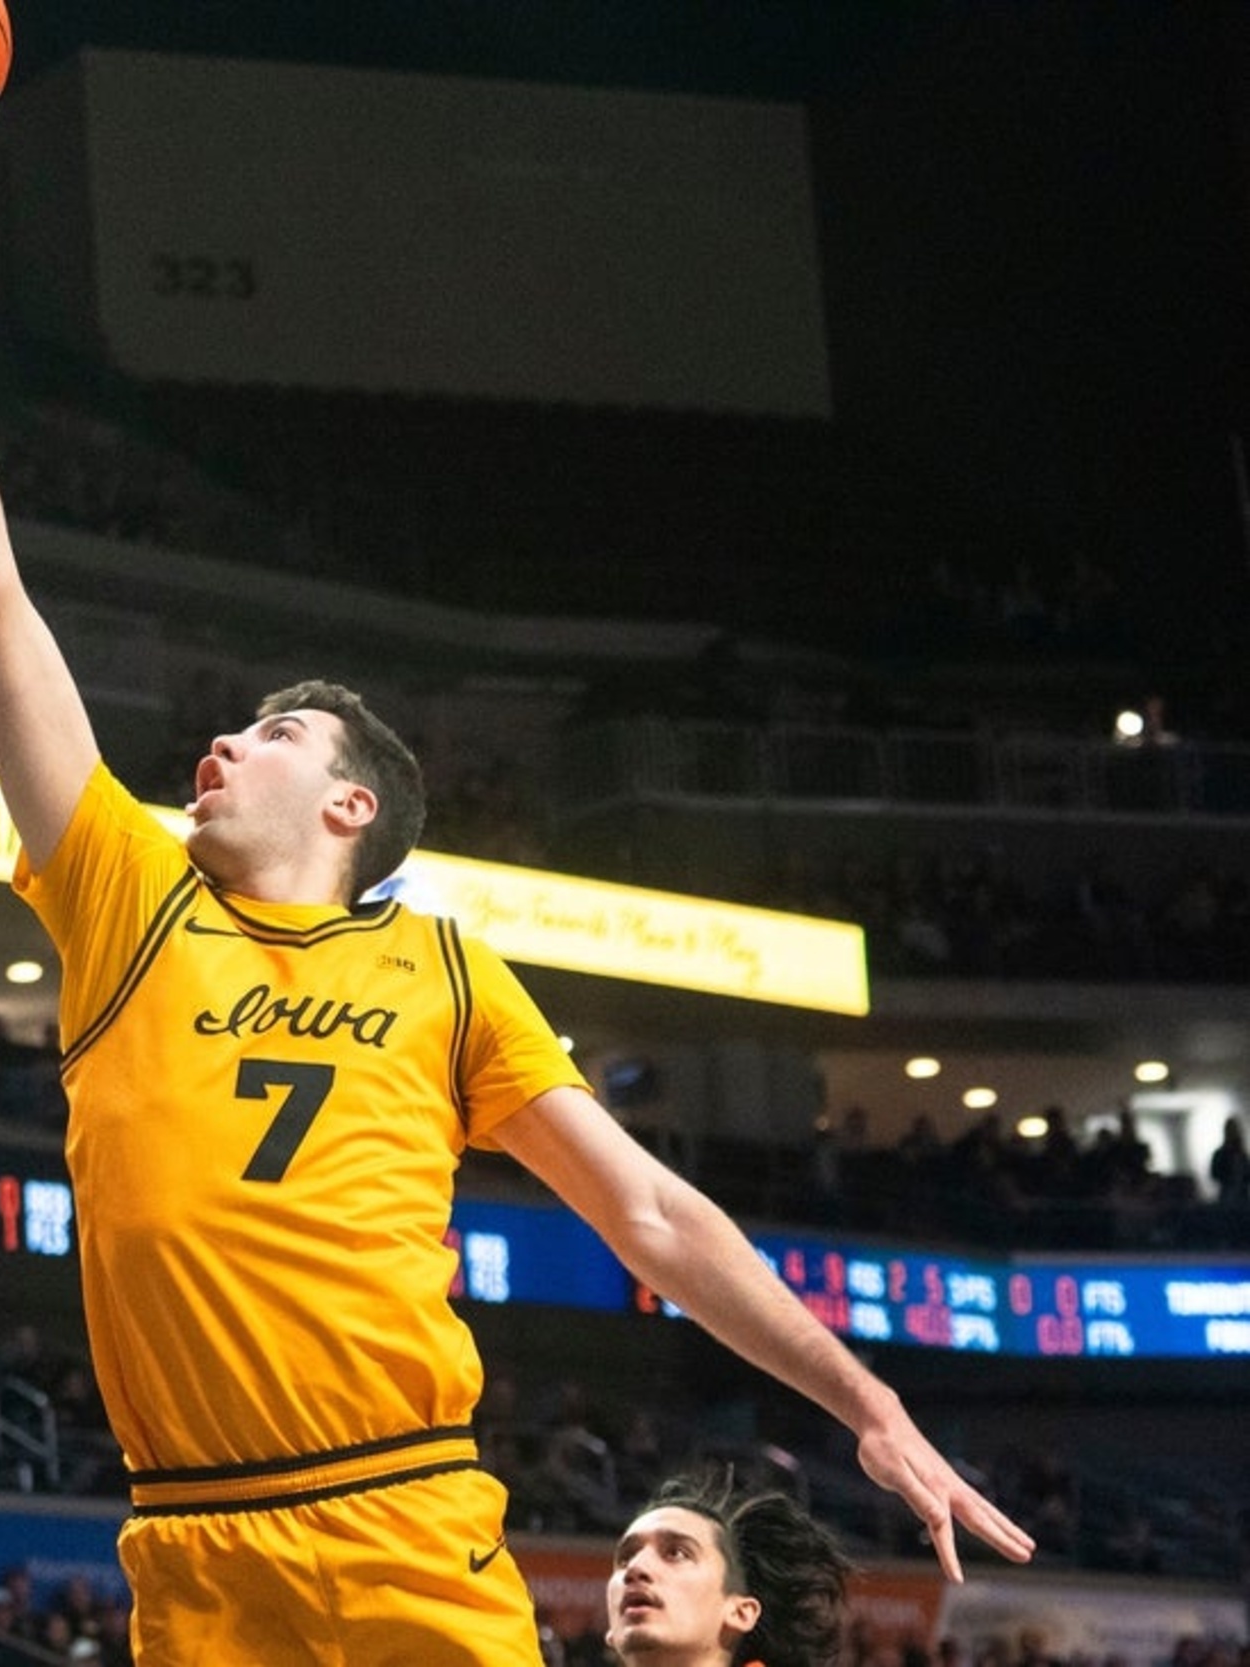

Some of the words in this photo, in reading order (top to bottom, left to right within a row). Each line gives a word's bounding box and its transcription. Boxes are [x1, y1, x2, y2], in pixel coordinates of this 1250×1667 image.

[151, 252, 257, 300] 323
[194, 983, 398, 1048] Iowa
[234, 1058, 336, 1183] 7
